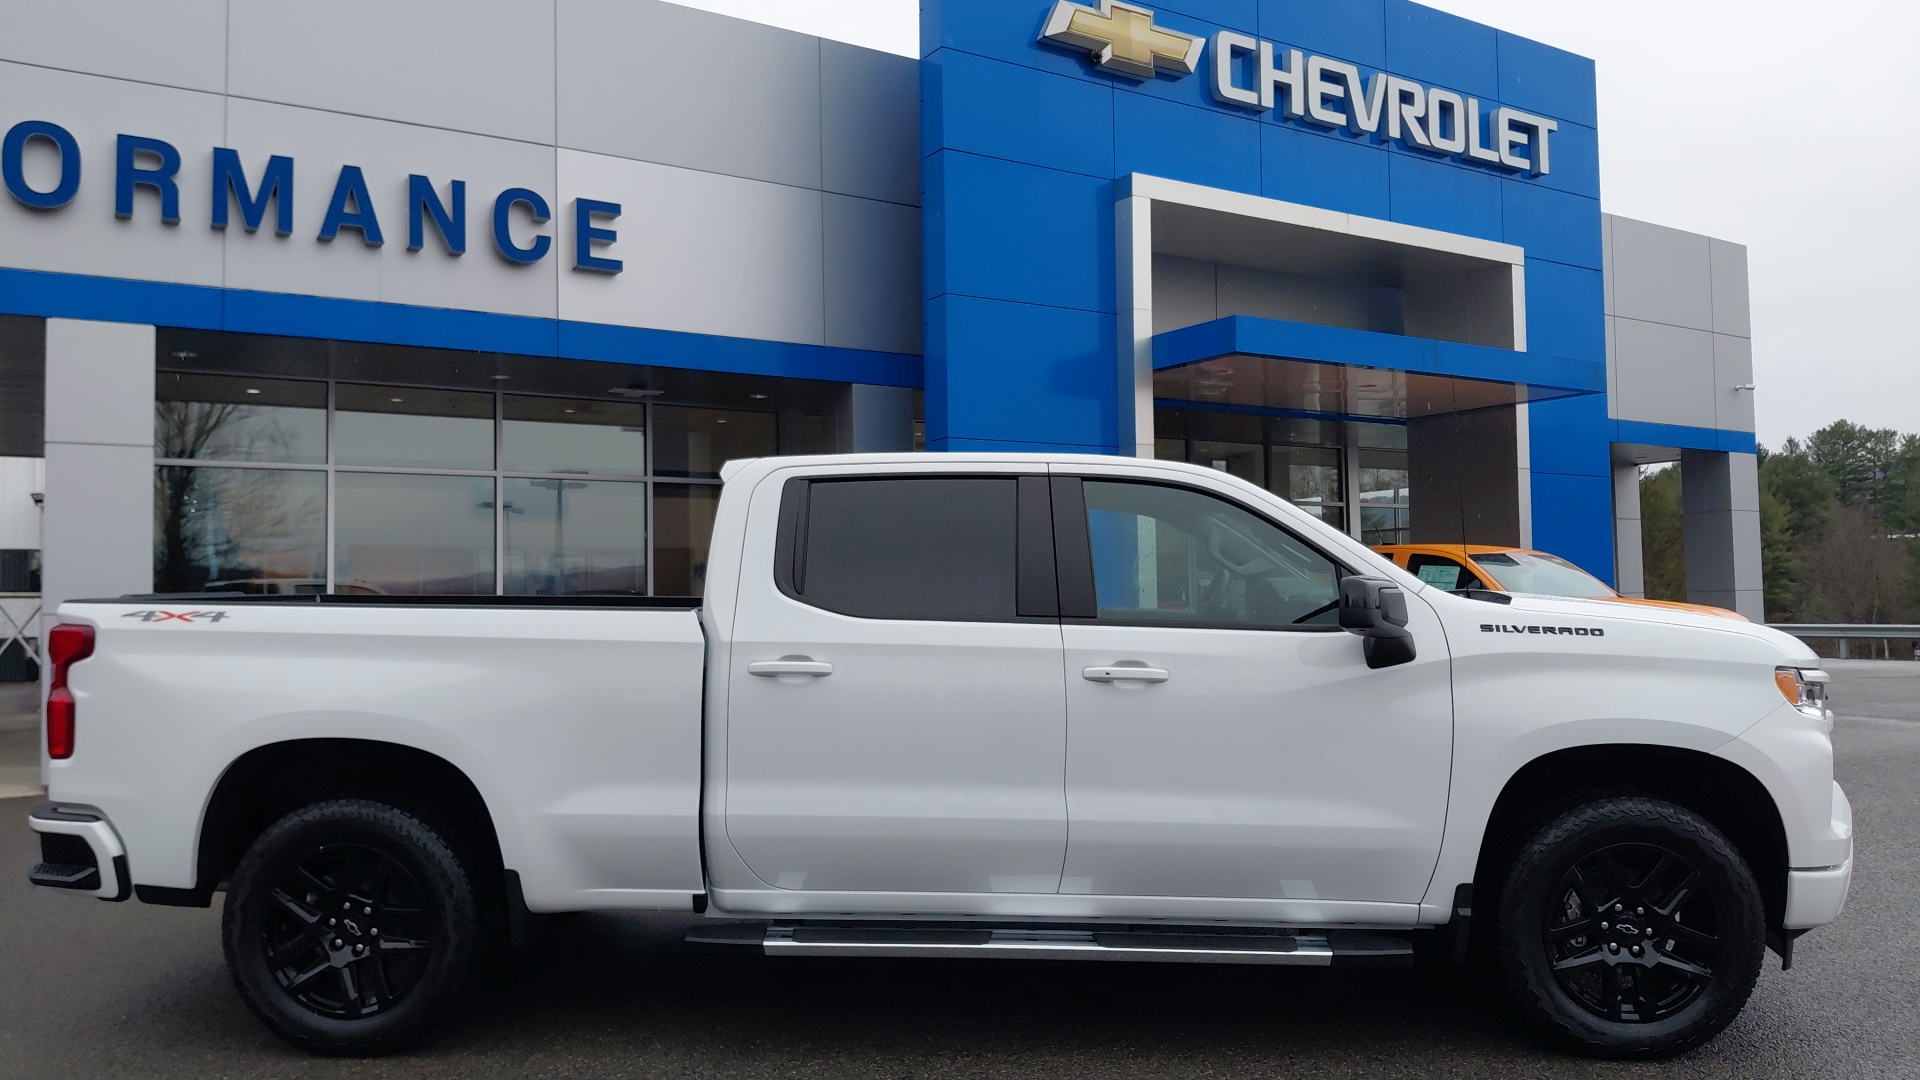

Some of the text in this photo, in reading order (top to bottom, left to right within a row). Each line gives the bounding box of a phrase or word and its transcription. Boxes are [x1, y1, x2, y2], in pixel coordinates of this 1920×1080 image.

[1210, 30, 1558, 177] CHEVROLET
[1, 120, 624, 275] ORMANCE
[1479, 623, 1605, 637] SILVERADO
